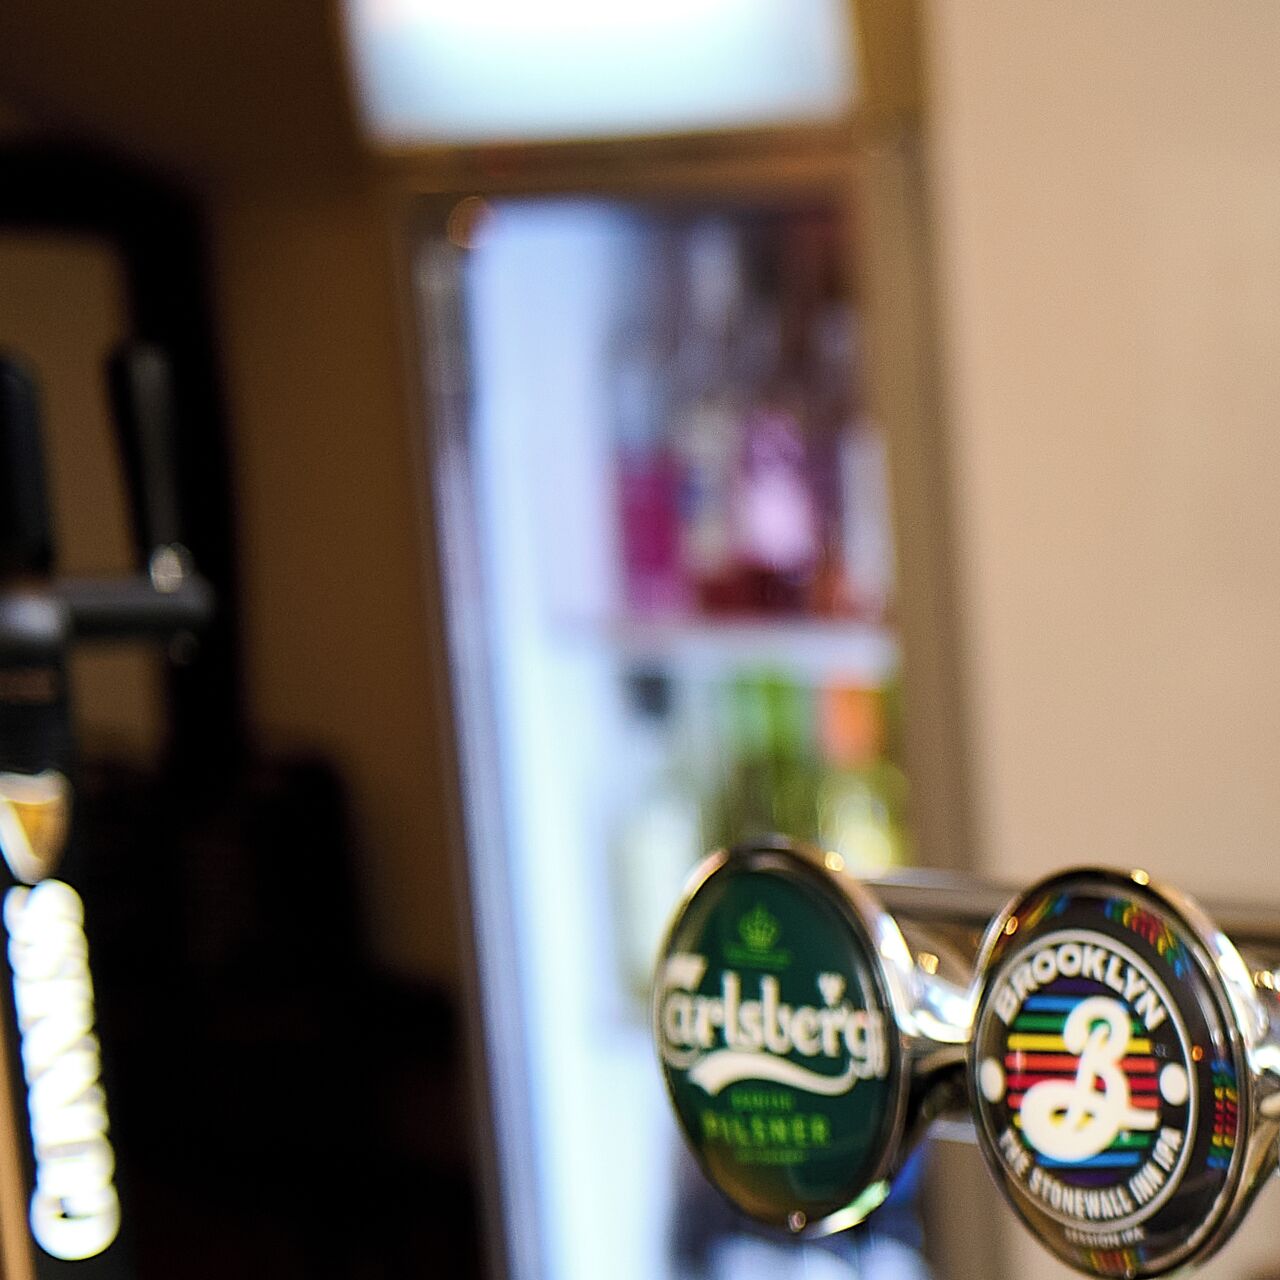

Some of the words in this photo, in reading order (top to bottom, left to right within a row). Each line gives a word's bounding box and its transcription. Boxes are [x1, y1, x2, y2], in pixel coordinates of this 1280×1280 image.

[993, 943, 1167, 1031] BROOKLYN
[998, 1125, 1032, 1178] THE
[1029, 1166, 1135, 1220] STONEWALL
[1128, 1160, 1166, 1206] INN
